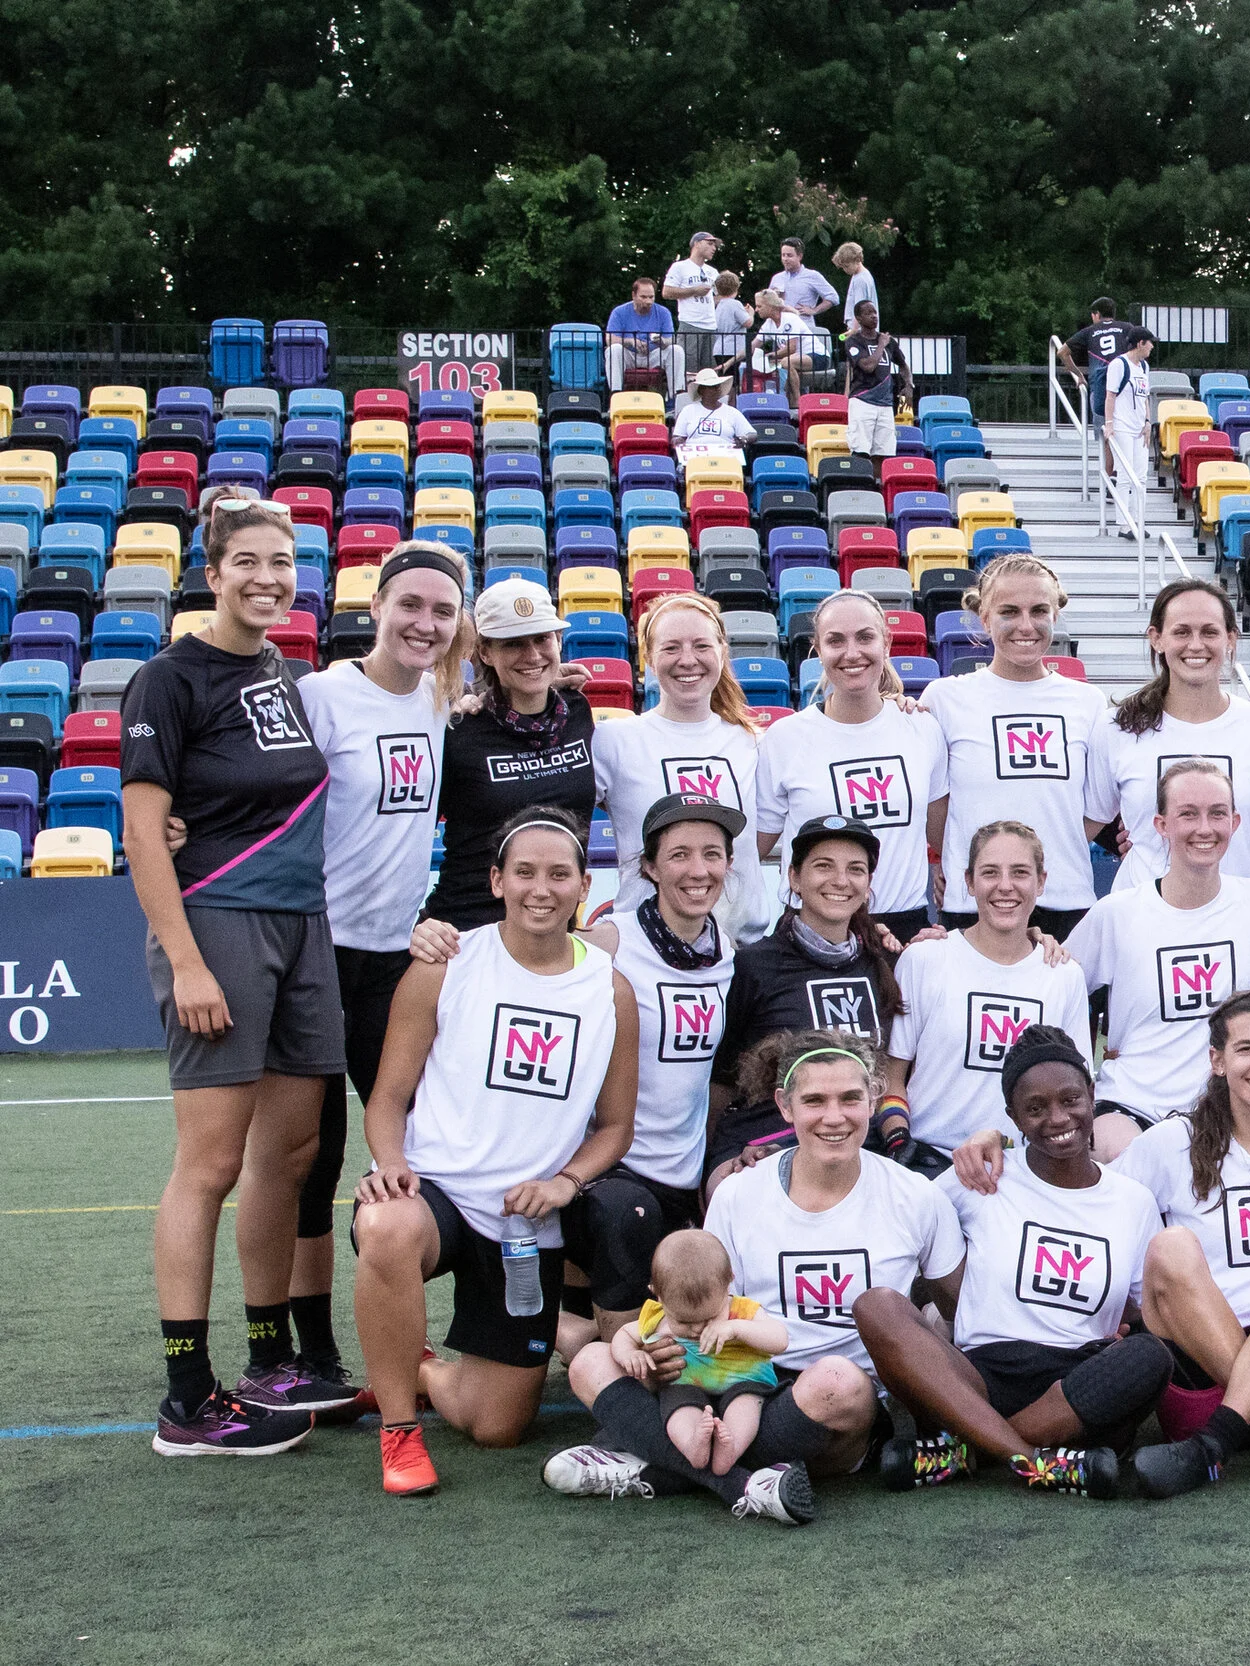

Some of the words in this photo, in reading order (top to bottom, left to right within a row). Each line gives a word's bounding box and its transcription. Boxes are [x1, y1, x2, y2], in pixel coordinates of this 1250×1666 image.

[402, 333, 509, 358] SECTION
[1100, 334, 1116, 355] 9
[409, 360, 503, 398] 103
[518, 751, 536, 759] NEW
[540, 746, 562, 758] YORK
[1006, 730, 1054, 754] NY
[390, 754, 424, 786] NY
[496, 746, 584, 774] GRIDLOCK
[524, 766, 569, 780] ULTIMATE
[678, 774, 722, 798] NY
[846, 774, 894, 804] NY
[1172, 962, 1221, 994] NY
[674, 1004, 716, 1034] NY
[822, 996, 863, 1024] NY
[8, 1006, 50, 1044] O
[980, 1014, 1031, 1044] NY
[506, 1028, 564, 1066] NY
[1034, 1244, 1095, 1281] NY
[796, 1272, 855, 1306] NY
[248, 1322, 275, 1330] EAVY
[164, 1338, 195, 1347] EAVY
[166, 1346, 195, 1356] UTY
